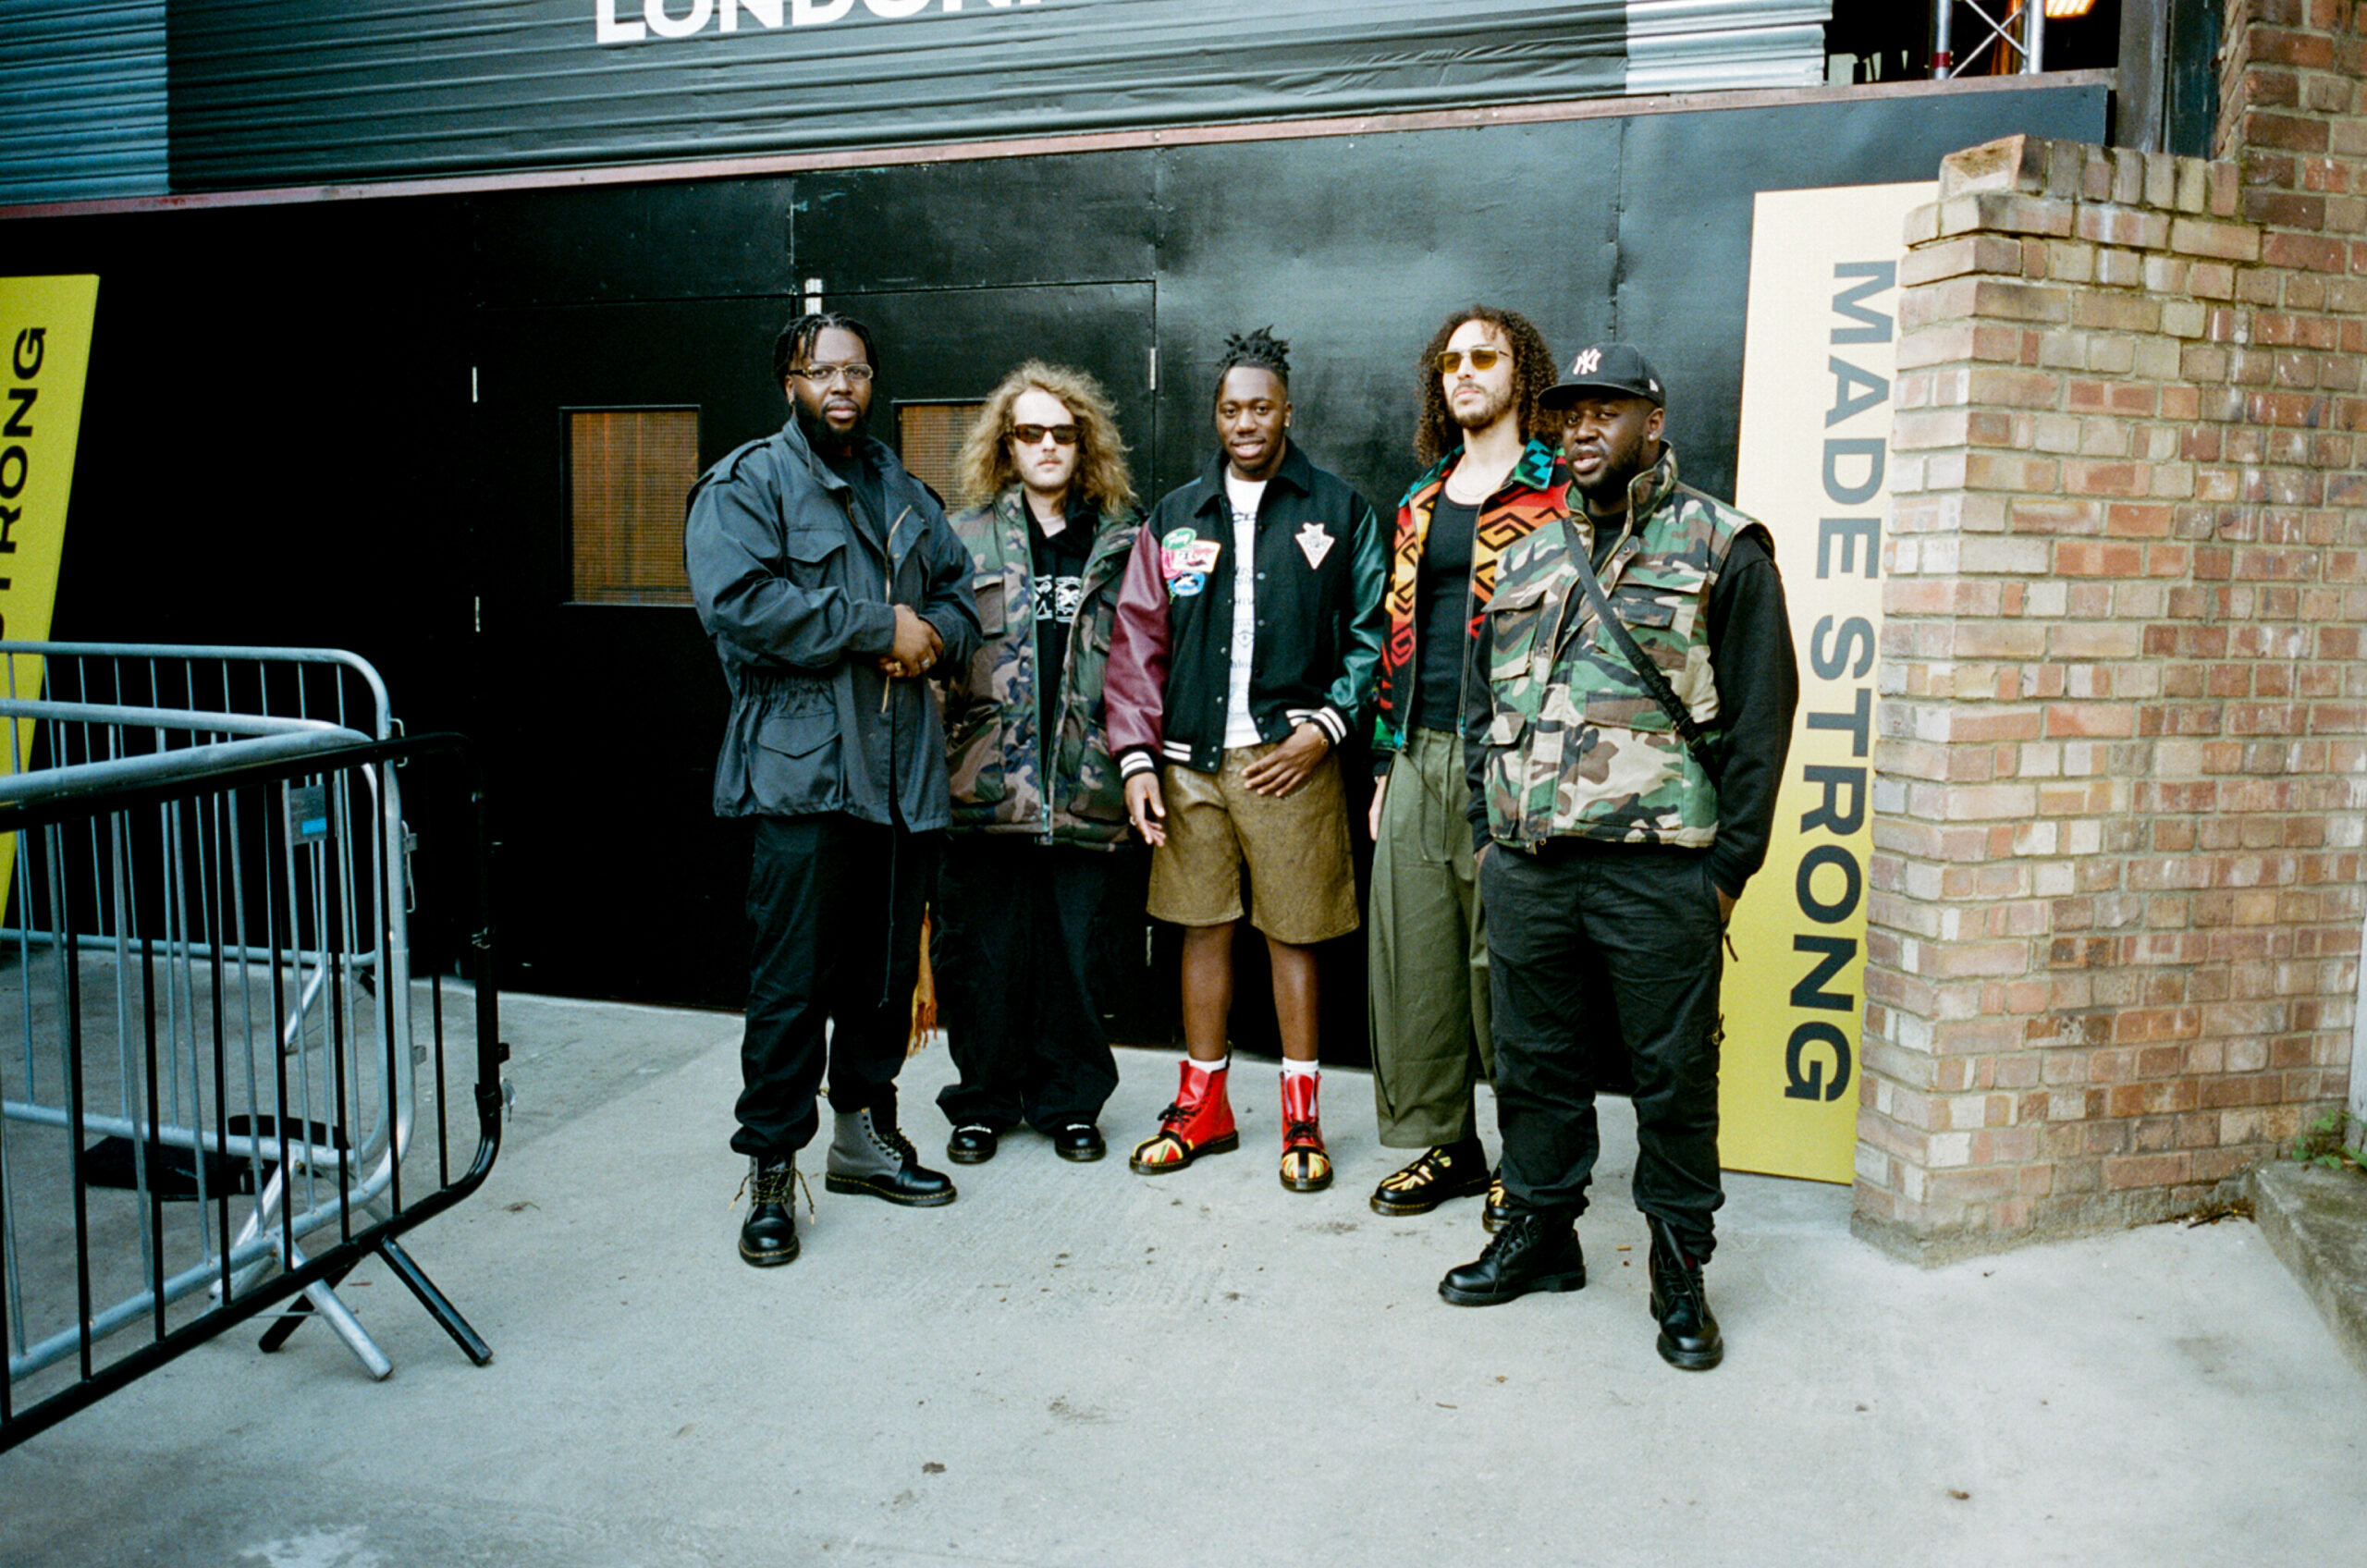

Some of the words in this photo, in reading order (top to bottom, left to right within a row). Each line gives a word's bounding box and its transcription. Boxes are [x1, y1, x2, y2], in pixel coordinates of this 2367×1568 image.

[596, 0, 1012, 43] LON
[0, 327, 46, 641] RONG
[1573, 348, 1601, 374] NY
[1816, 260, 1896, 580] MADE
[1784, 614, 1875, 1102] STRONG
